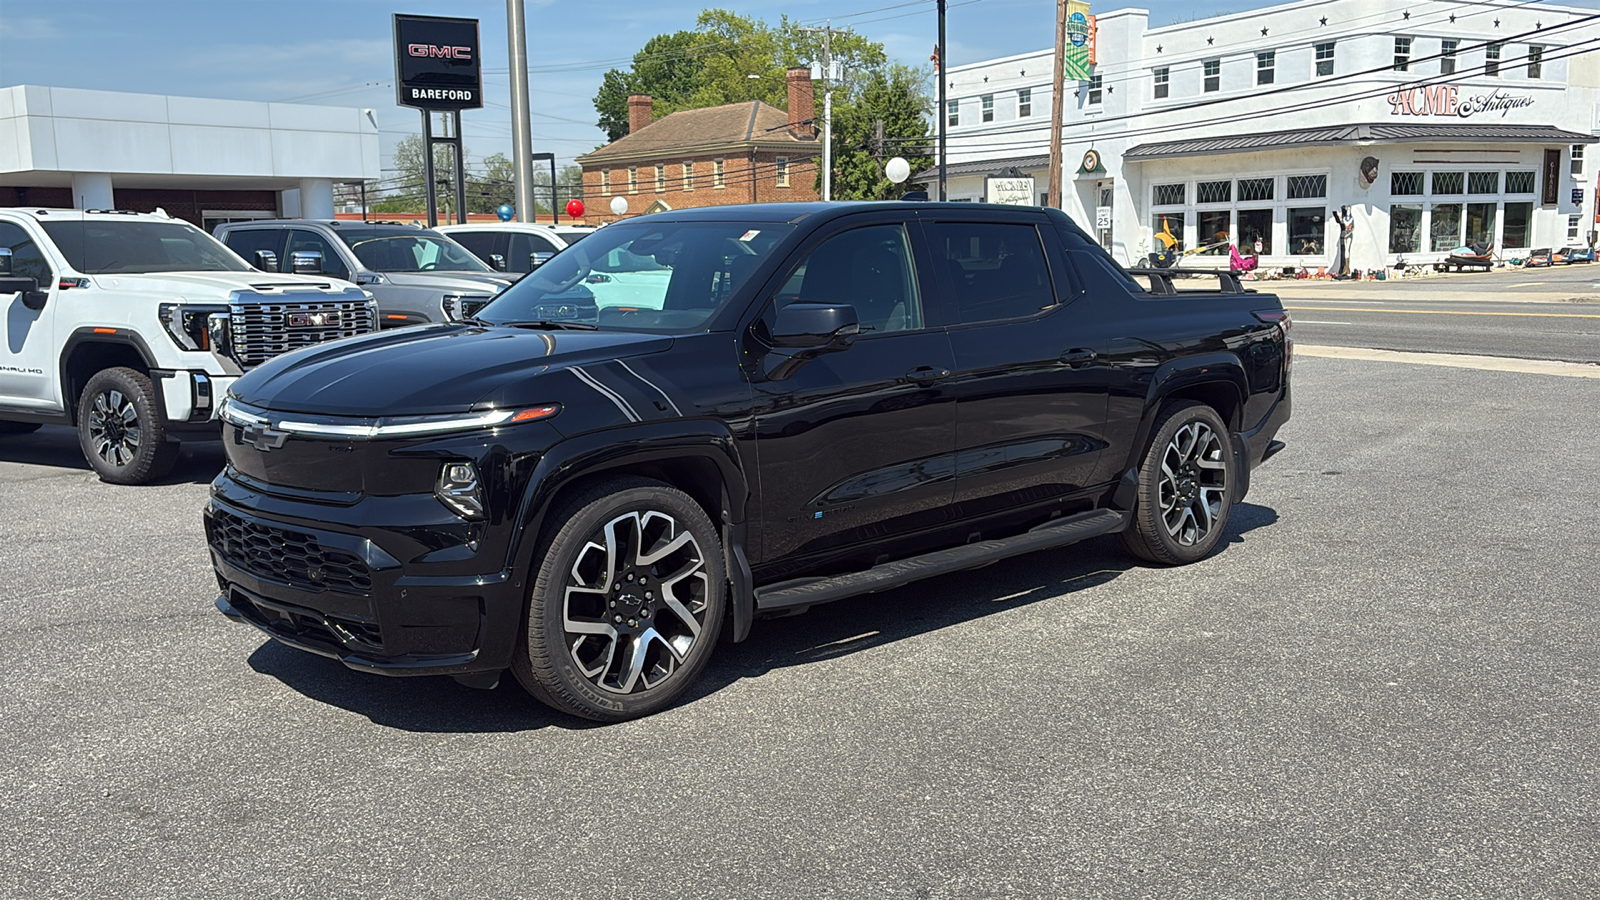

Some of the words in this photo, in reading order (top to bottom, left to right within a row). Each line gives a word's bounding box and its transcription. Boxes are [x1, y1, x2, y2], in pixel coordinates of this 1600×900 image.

[408, 43, 471, 60] GMC
[411, 88, 472, 101] BAREFORD
[1388, 84, 1459, 116] ACME
[1459, 87, 1535, 118] Antiques
[1097, 217, 1109, 227] 25
[289, 312, 340, 327] GMC
